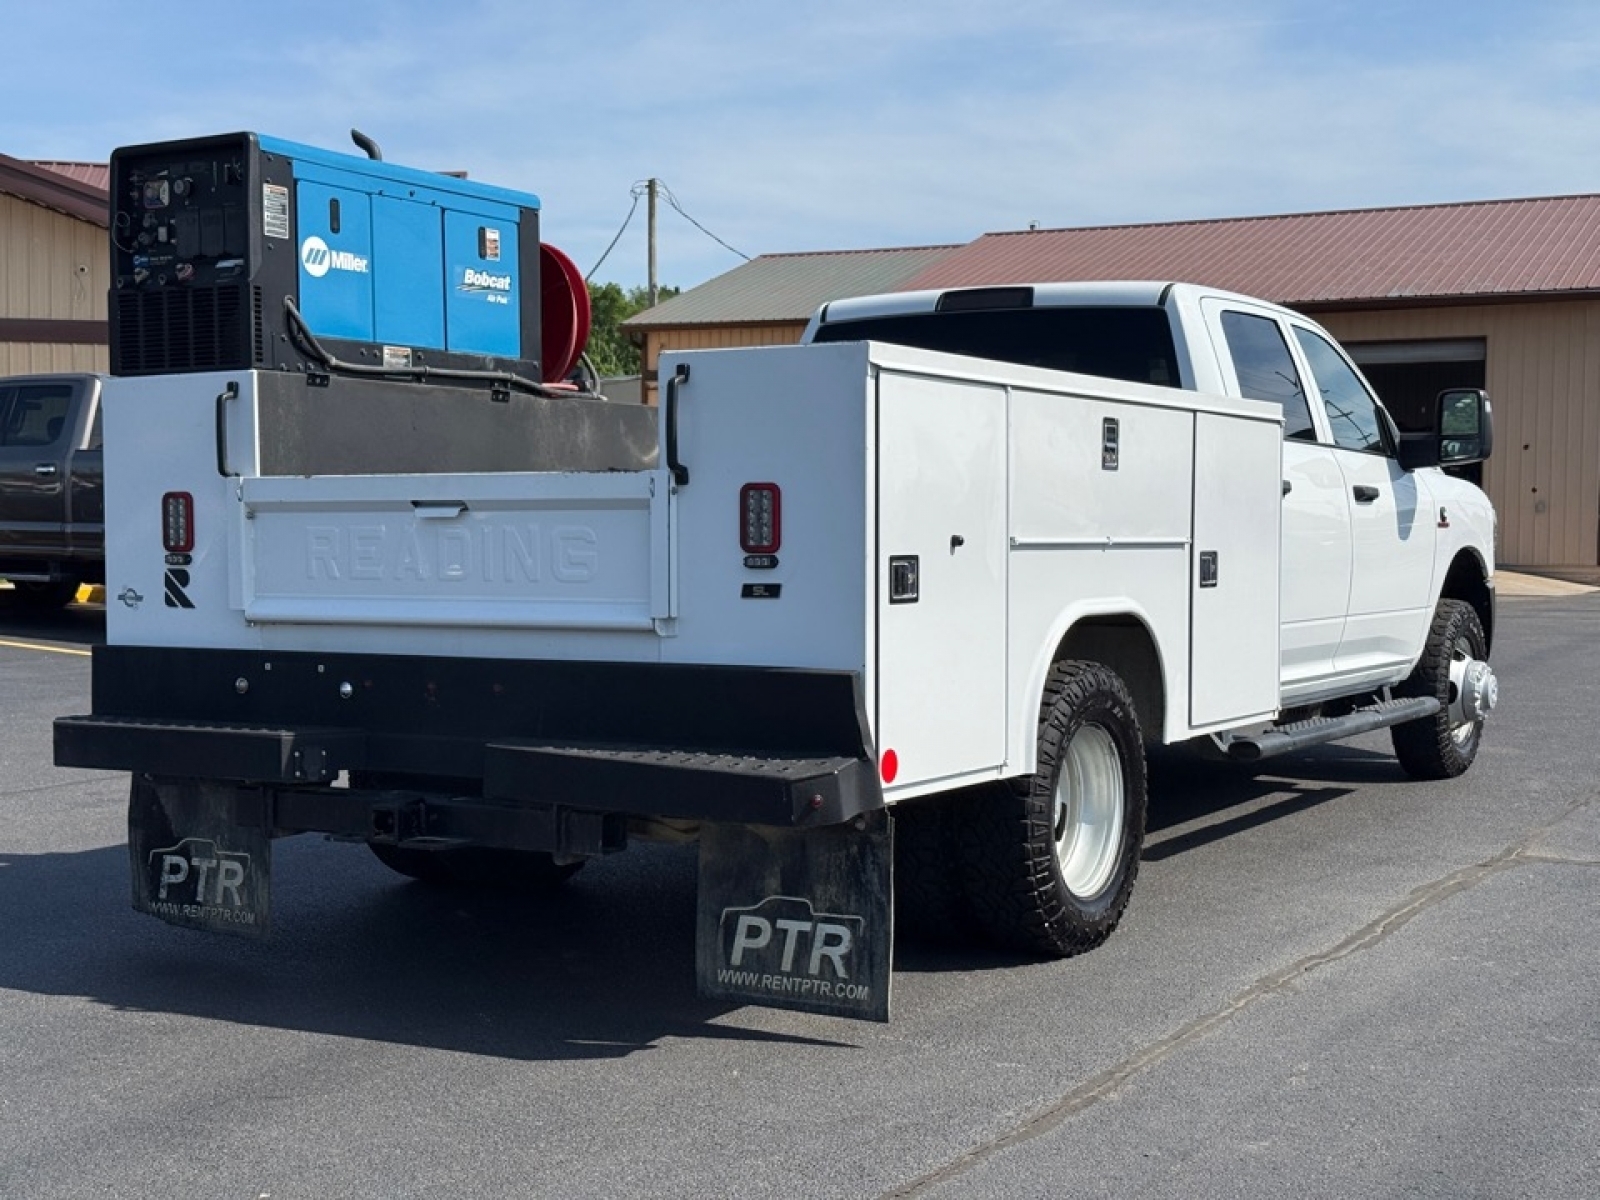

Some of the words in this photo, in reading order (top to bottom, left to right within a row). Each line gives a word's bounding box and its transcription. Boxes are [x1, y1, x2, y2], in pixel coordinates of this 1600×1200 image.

[464, 268, 511, 291] Bobcat
[306, 524, 600, 584] READING
[158, 854, 245, 906] PTR
[149, 902, 256, 925] WWW.RENTPTR.COM
[730, 915, 852, 979] PTR
[717, 968, 869, 1000] WWW.RENTPTR.COM
